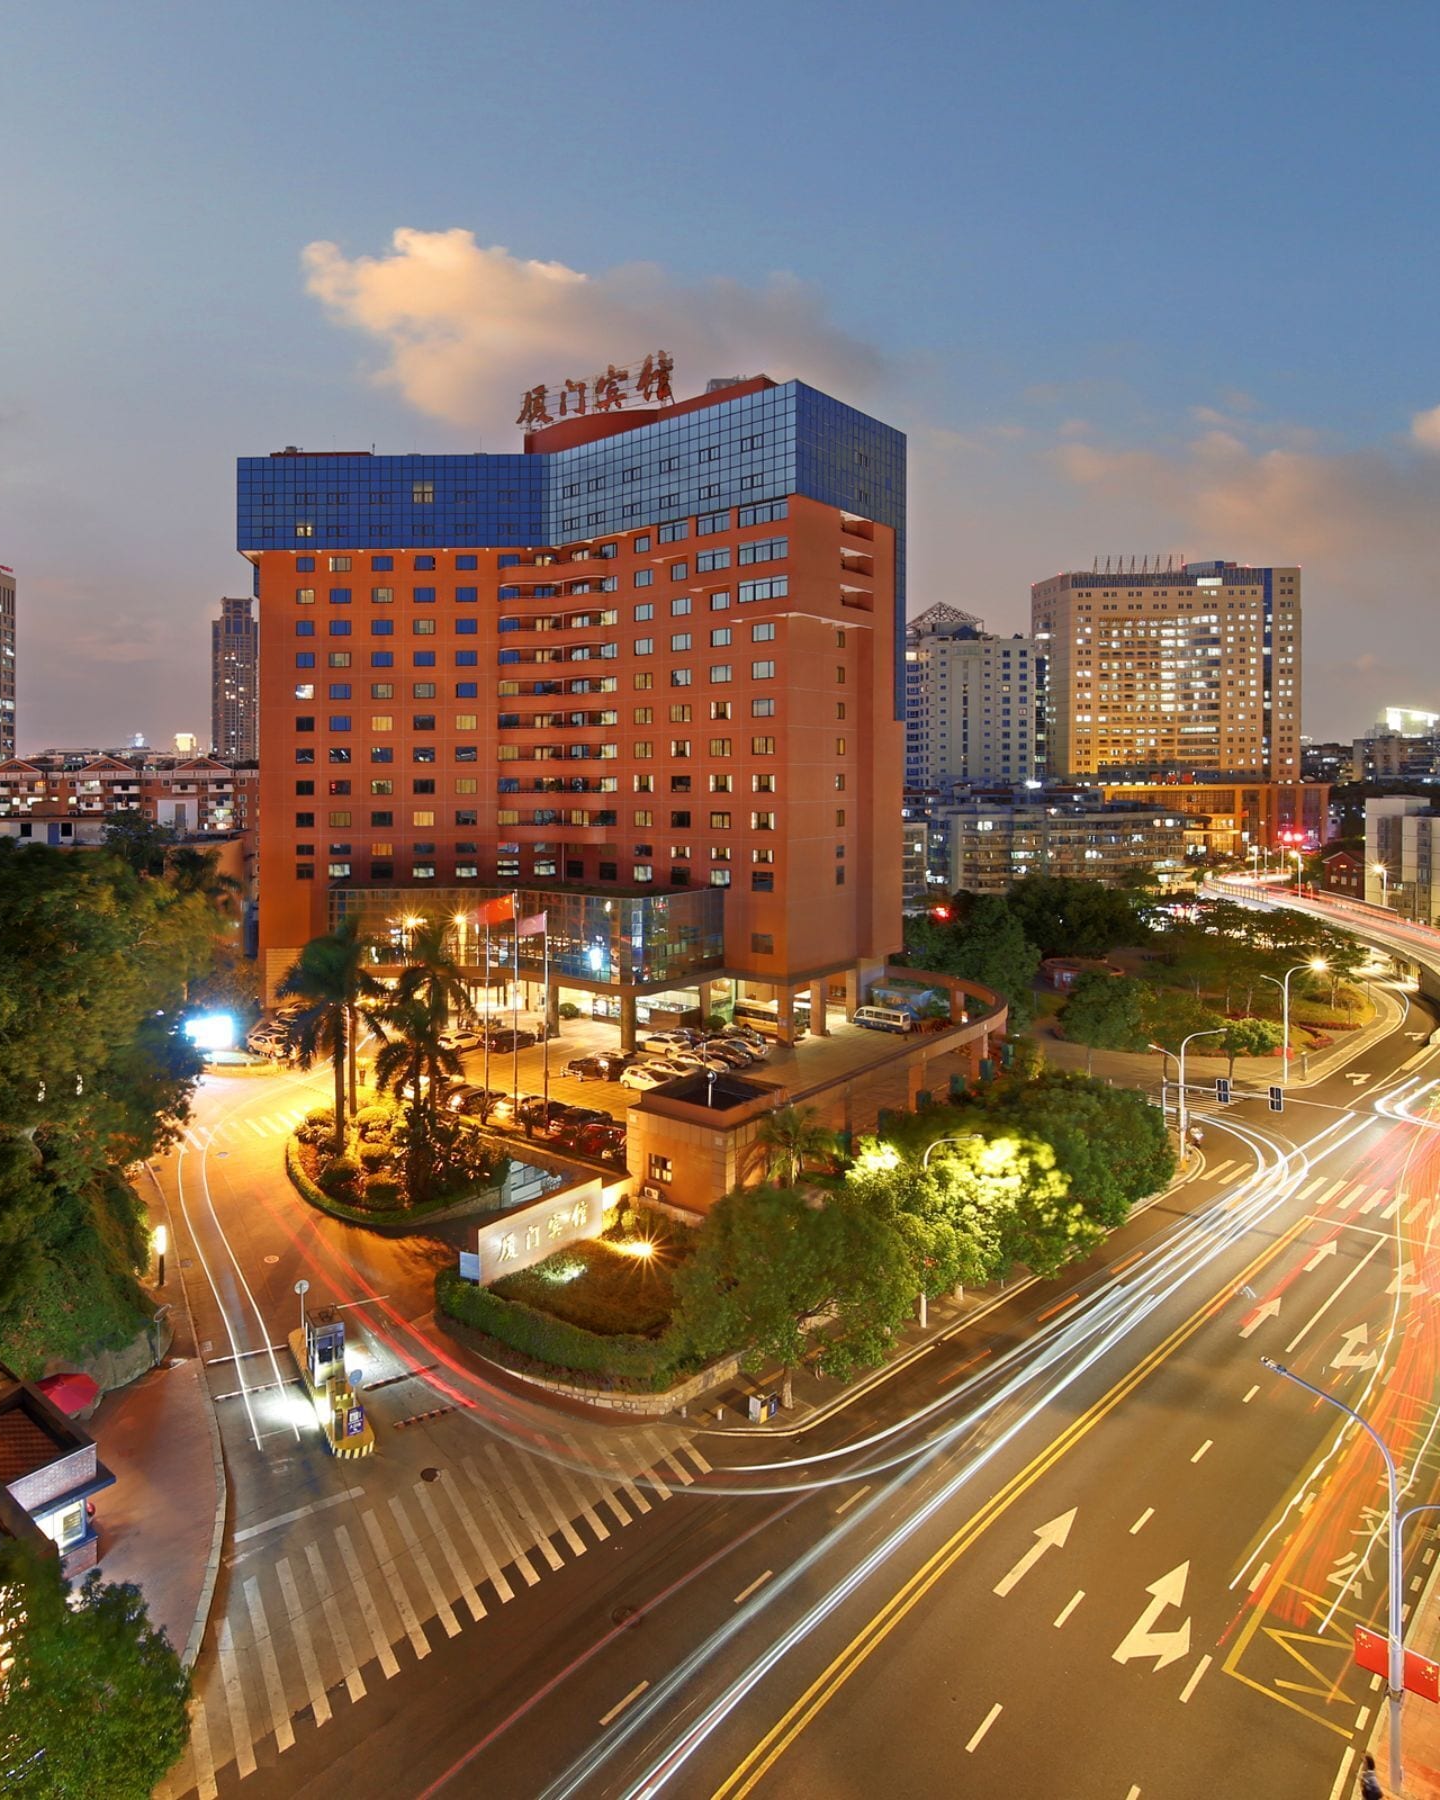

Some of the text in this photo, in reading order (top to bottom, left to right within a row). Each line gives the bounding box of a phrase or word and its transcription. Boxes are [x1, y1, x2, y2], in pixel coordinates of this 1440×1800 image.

[516, 350, 673, 425] 厦门宾馆
[498, 1200, 588, 1262] 厦门宾馆
